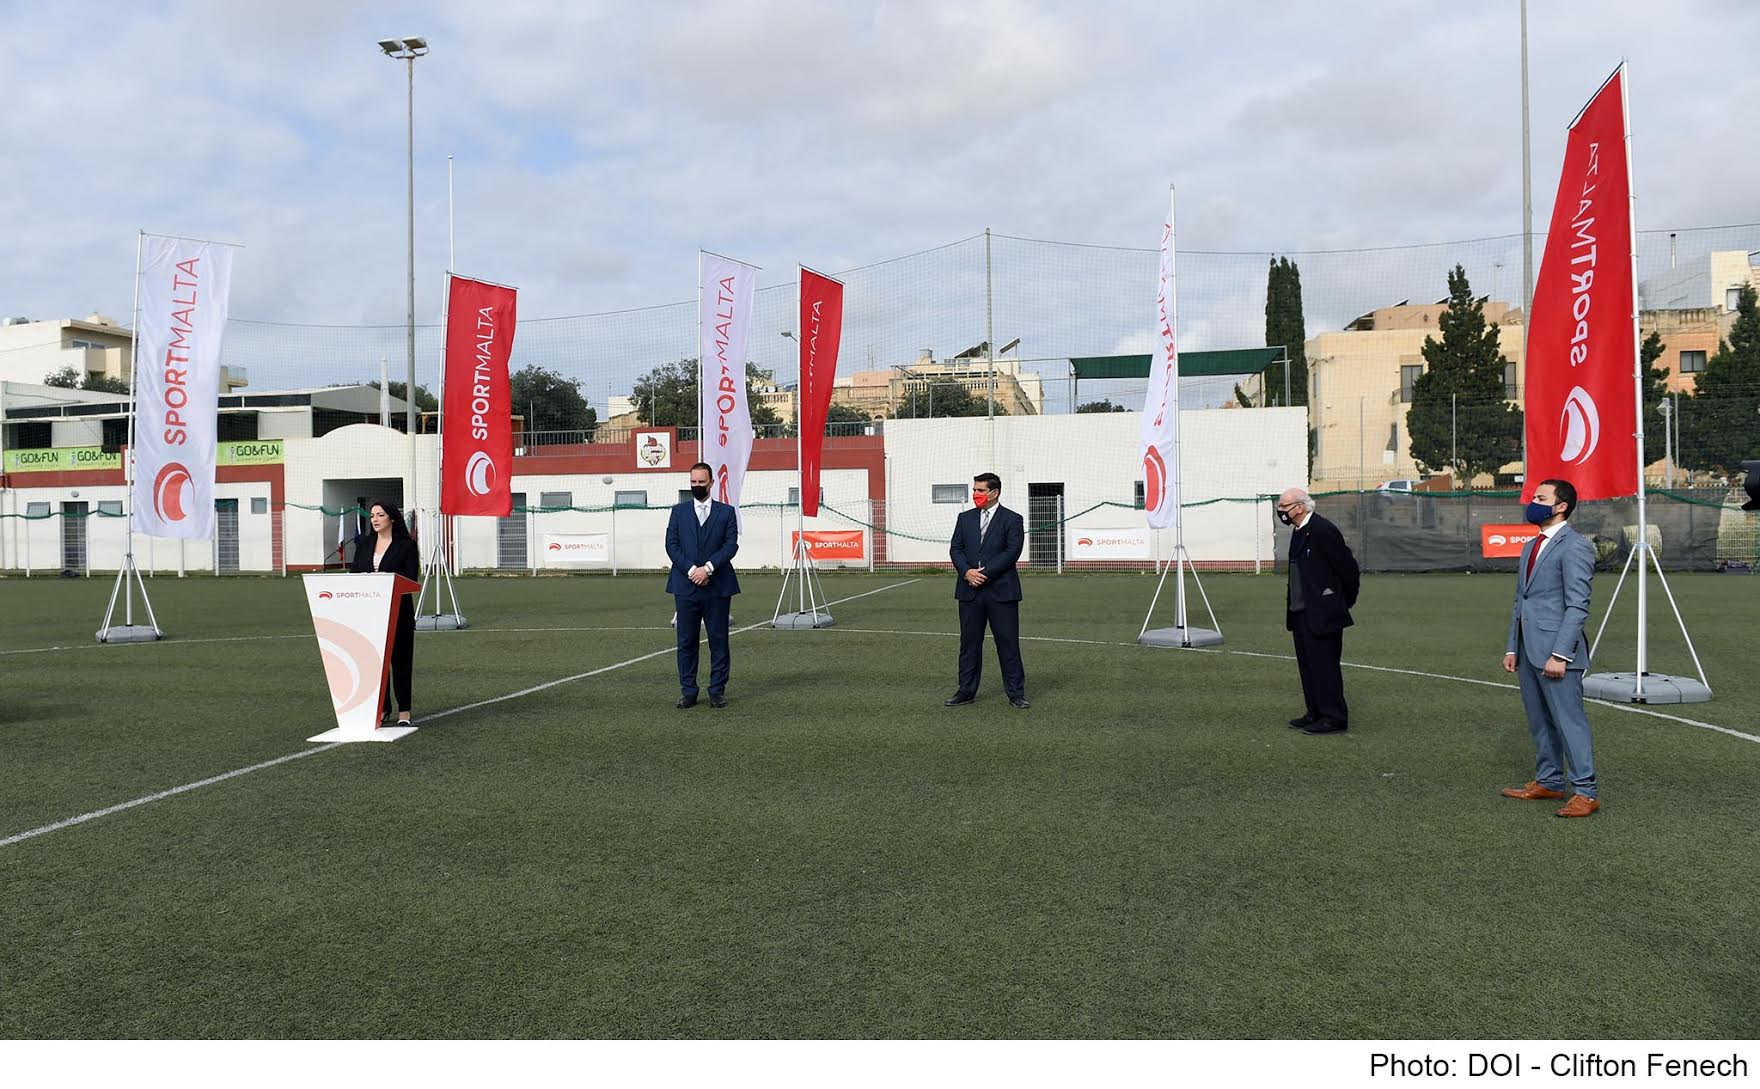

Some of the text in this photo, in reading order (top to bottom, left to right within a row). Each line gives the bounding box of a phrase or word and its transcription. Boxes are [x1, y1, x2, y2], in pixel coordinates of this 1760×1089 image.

[163, 257, 200, 446] SPORTMALTA
[716, 276, 737, 448] SPORTMALTA
[471, 306, 495, 441] SPORTMALTA
[77, 450, 117, 461] GO&FUN
[236, 444, 279, 456] GO&FUN
[20, 452, 59, 464] GO&FUN
[814, 541, 859, 549] SPORTMALTA
[1096, 538, 1145, 546] SPORTMALTA
[336, 591, 381, 599] SPORTMALTA
